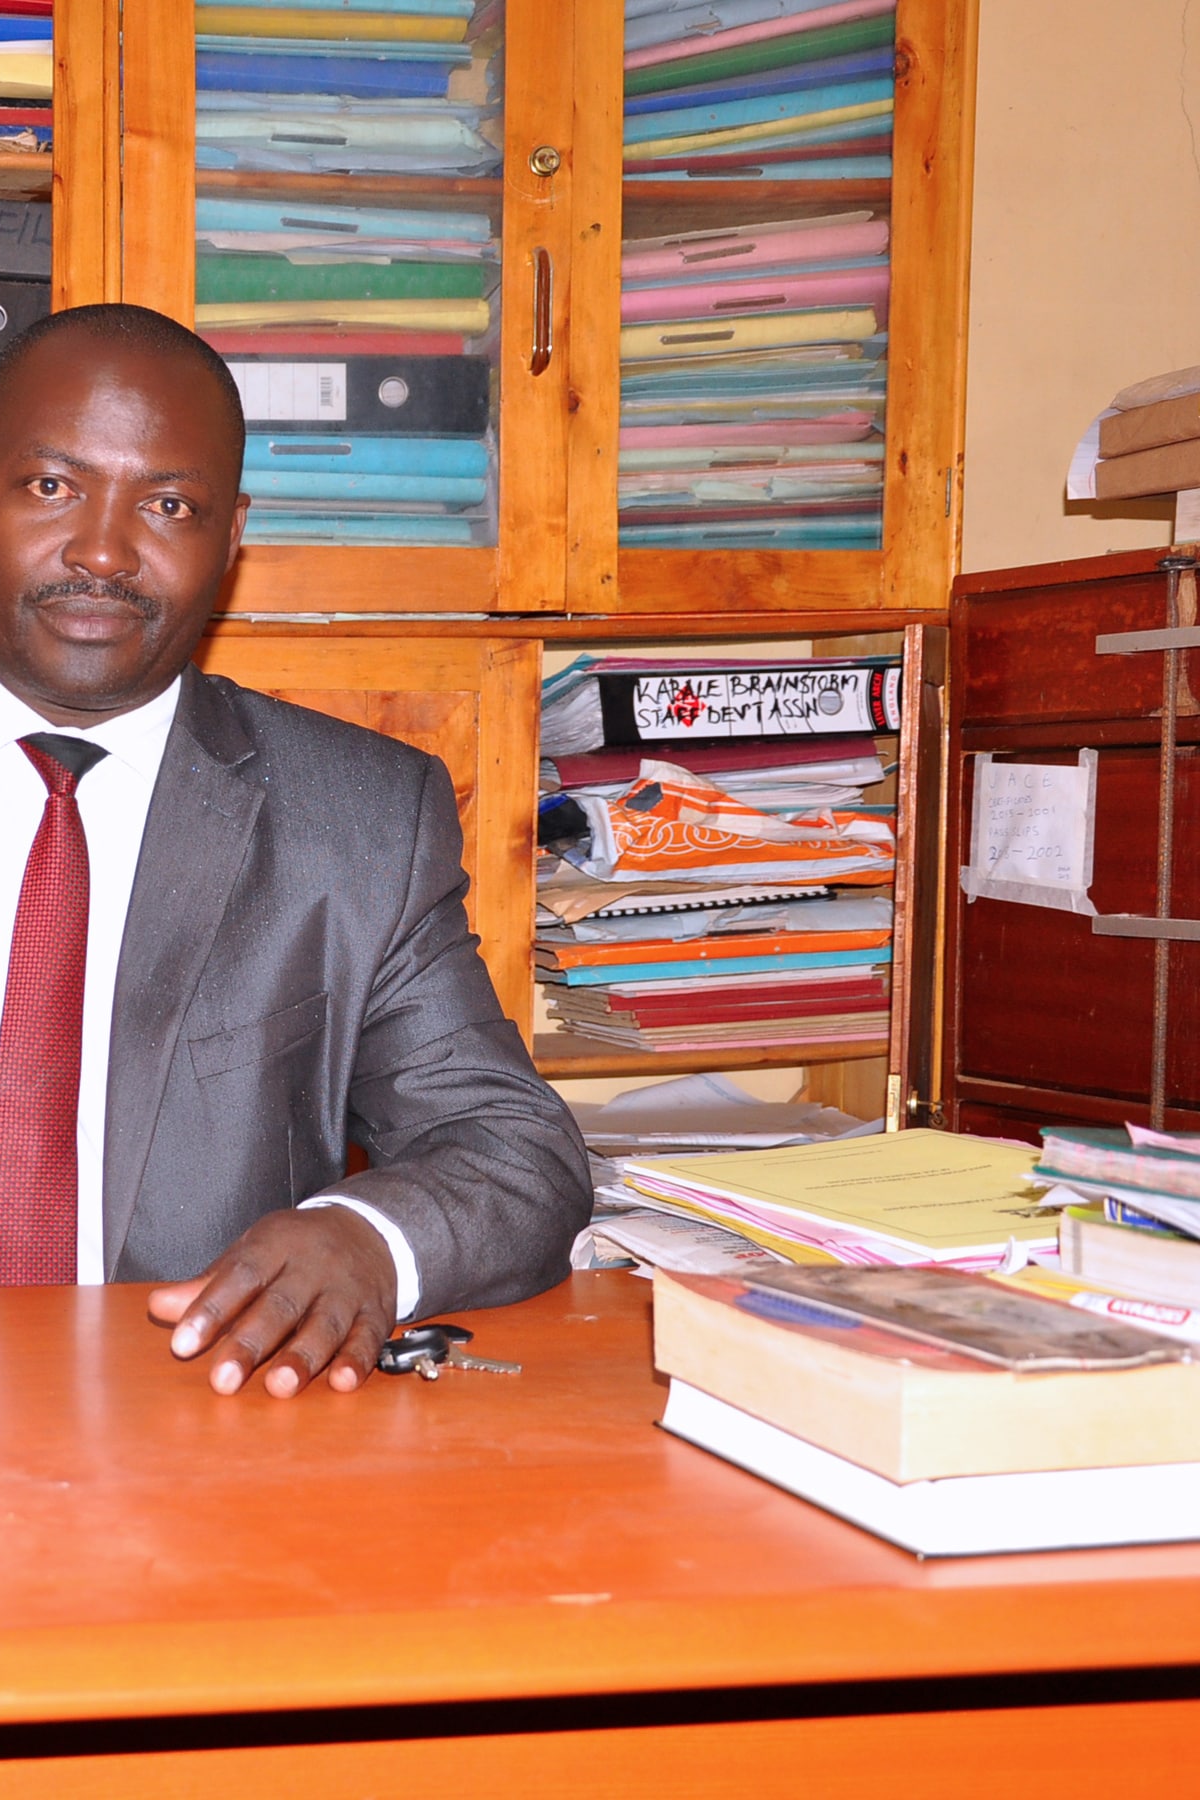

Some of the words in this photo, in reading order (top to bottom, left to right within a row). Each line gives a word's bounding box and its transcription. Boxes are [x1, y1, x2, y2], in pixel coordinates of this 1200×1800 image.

[637, 677, 722, 704] KABALE
[871, 672, 884, 698] ARCH
[637, 706, 700, 728] STAFF
